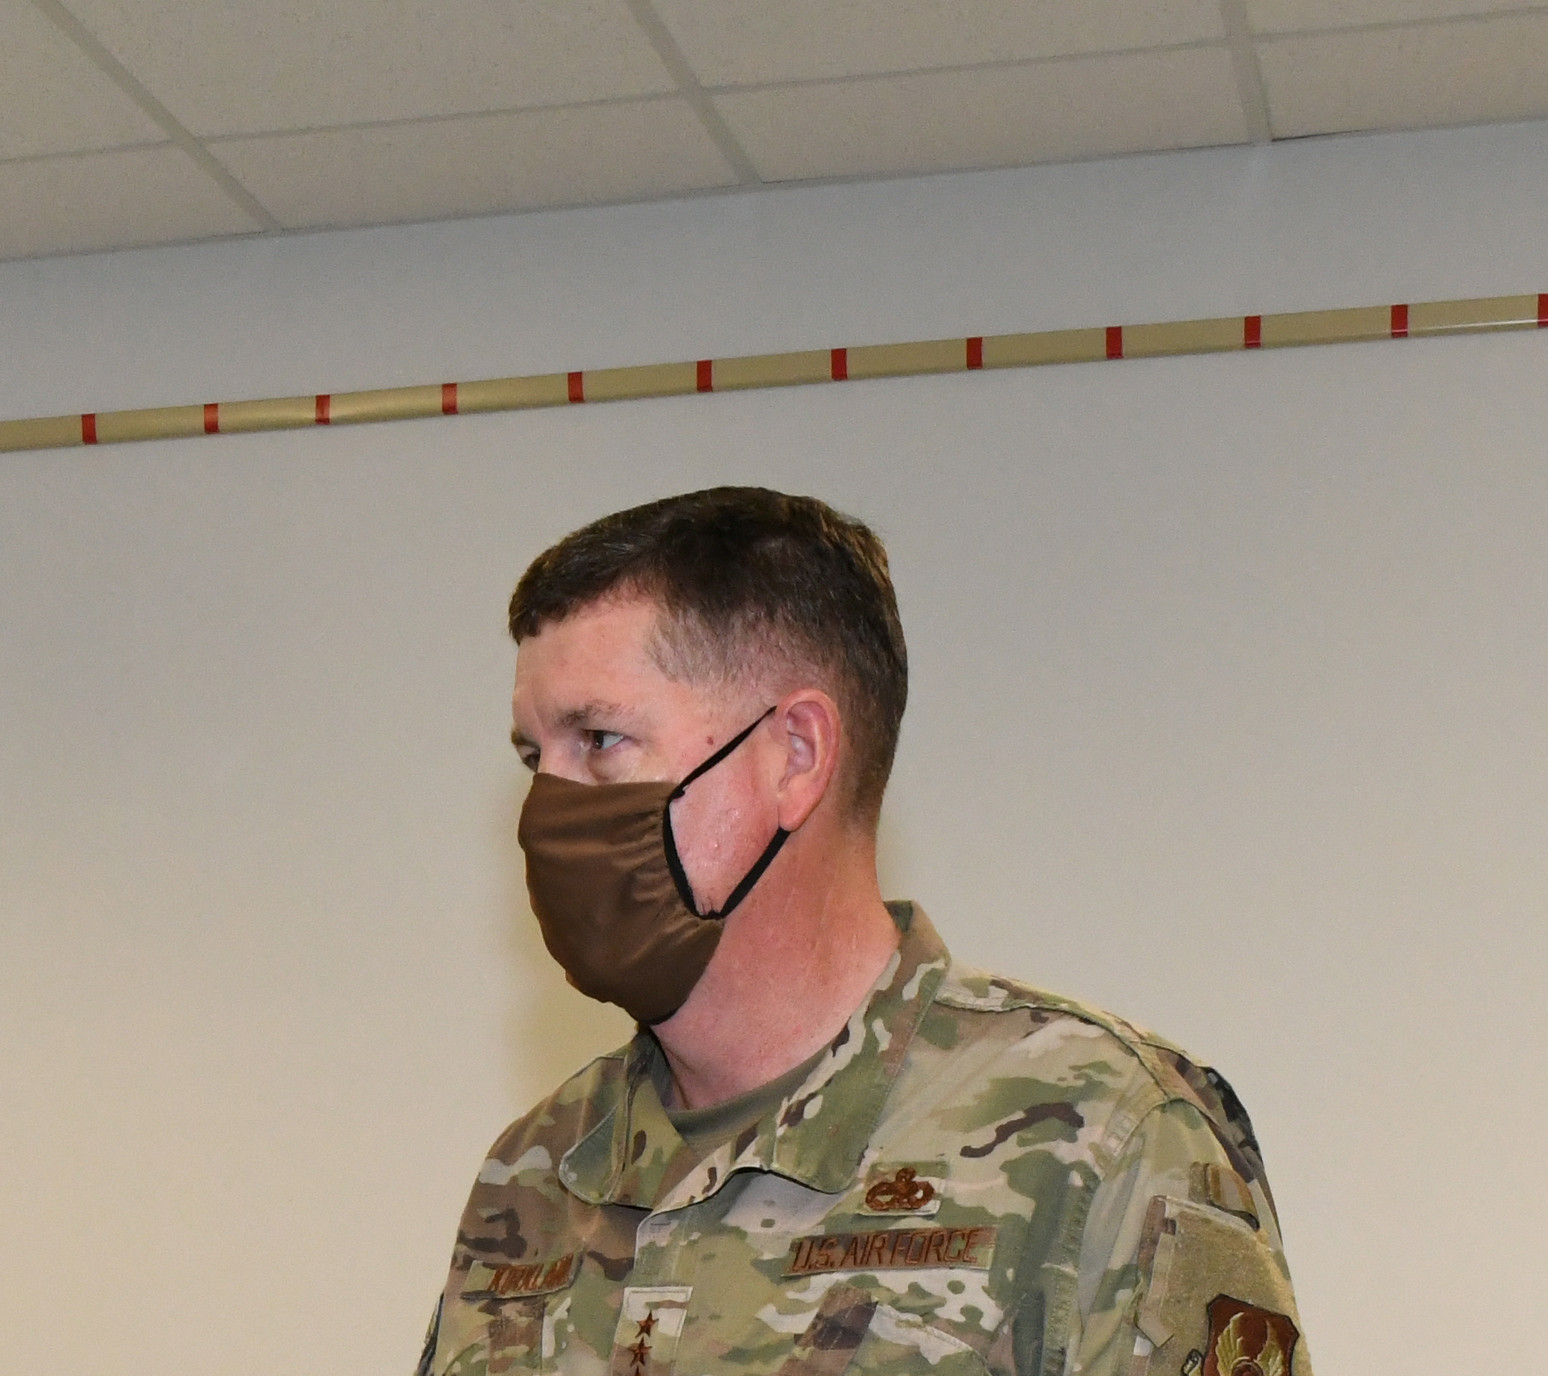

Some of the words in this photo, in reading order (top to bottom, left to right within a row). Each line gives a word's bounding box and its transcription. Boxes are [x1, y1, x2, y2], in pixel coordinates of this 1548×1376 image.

[792, 1237, 838, 1273] U.S.
[841, 1232, 889, 1267] AIR
[890, 1228, 980, 1265] FORCE
